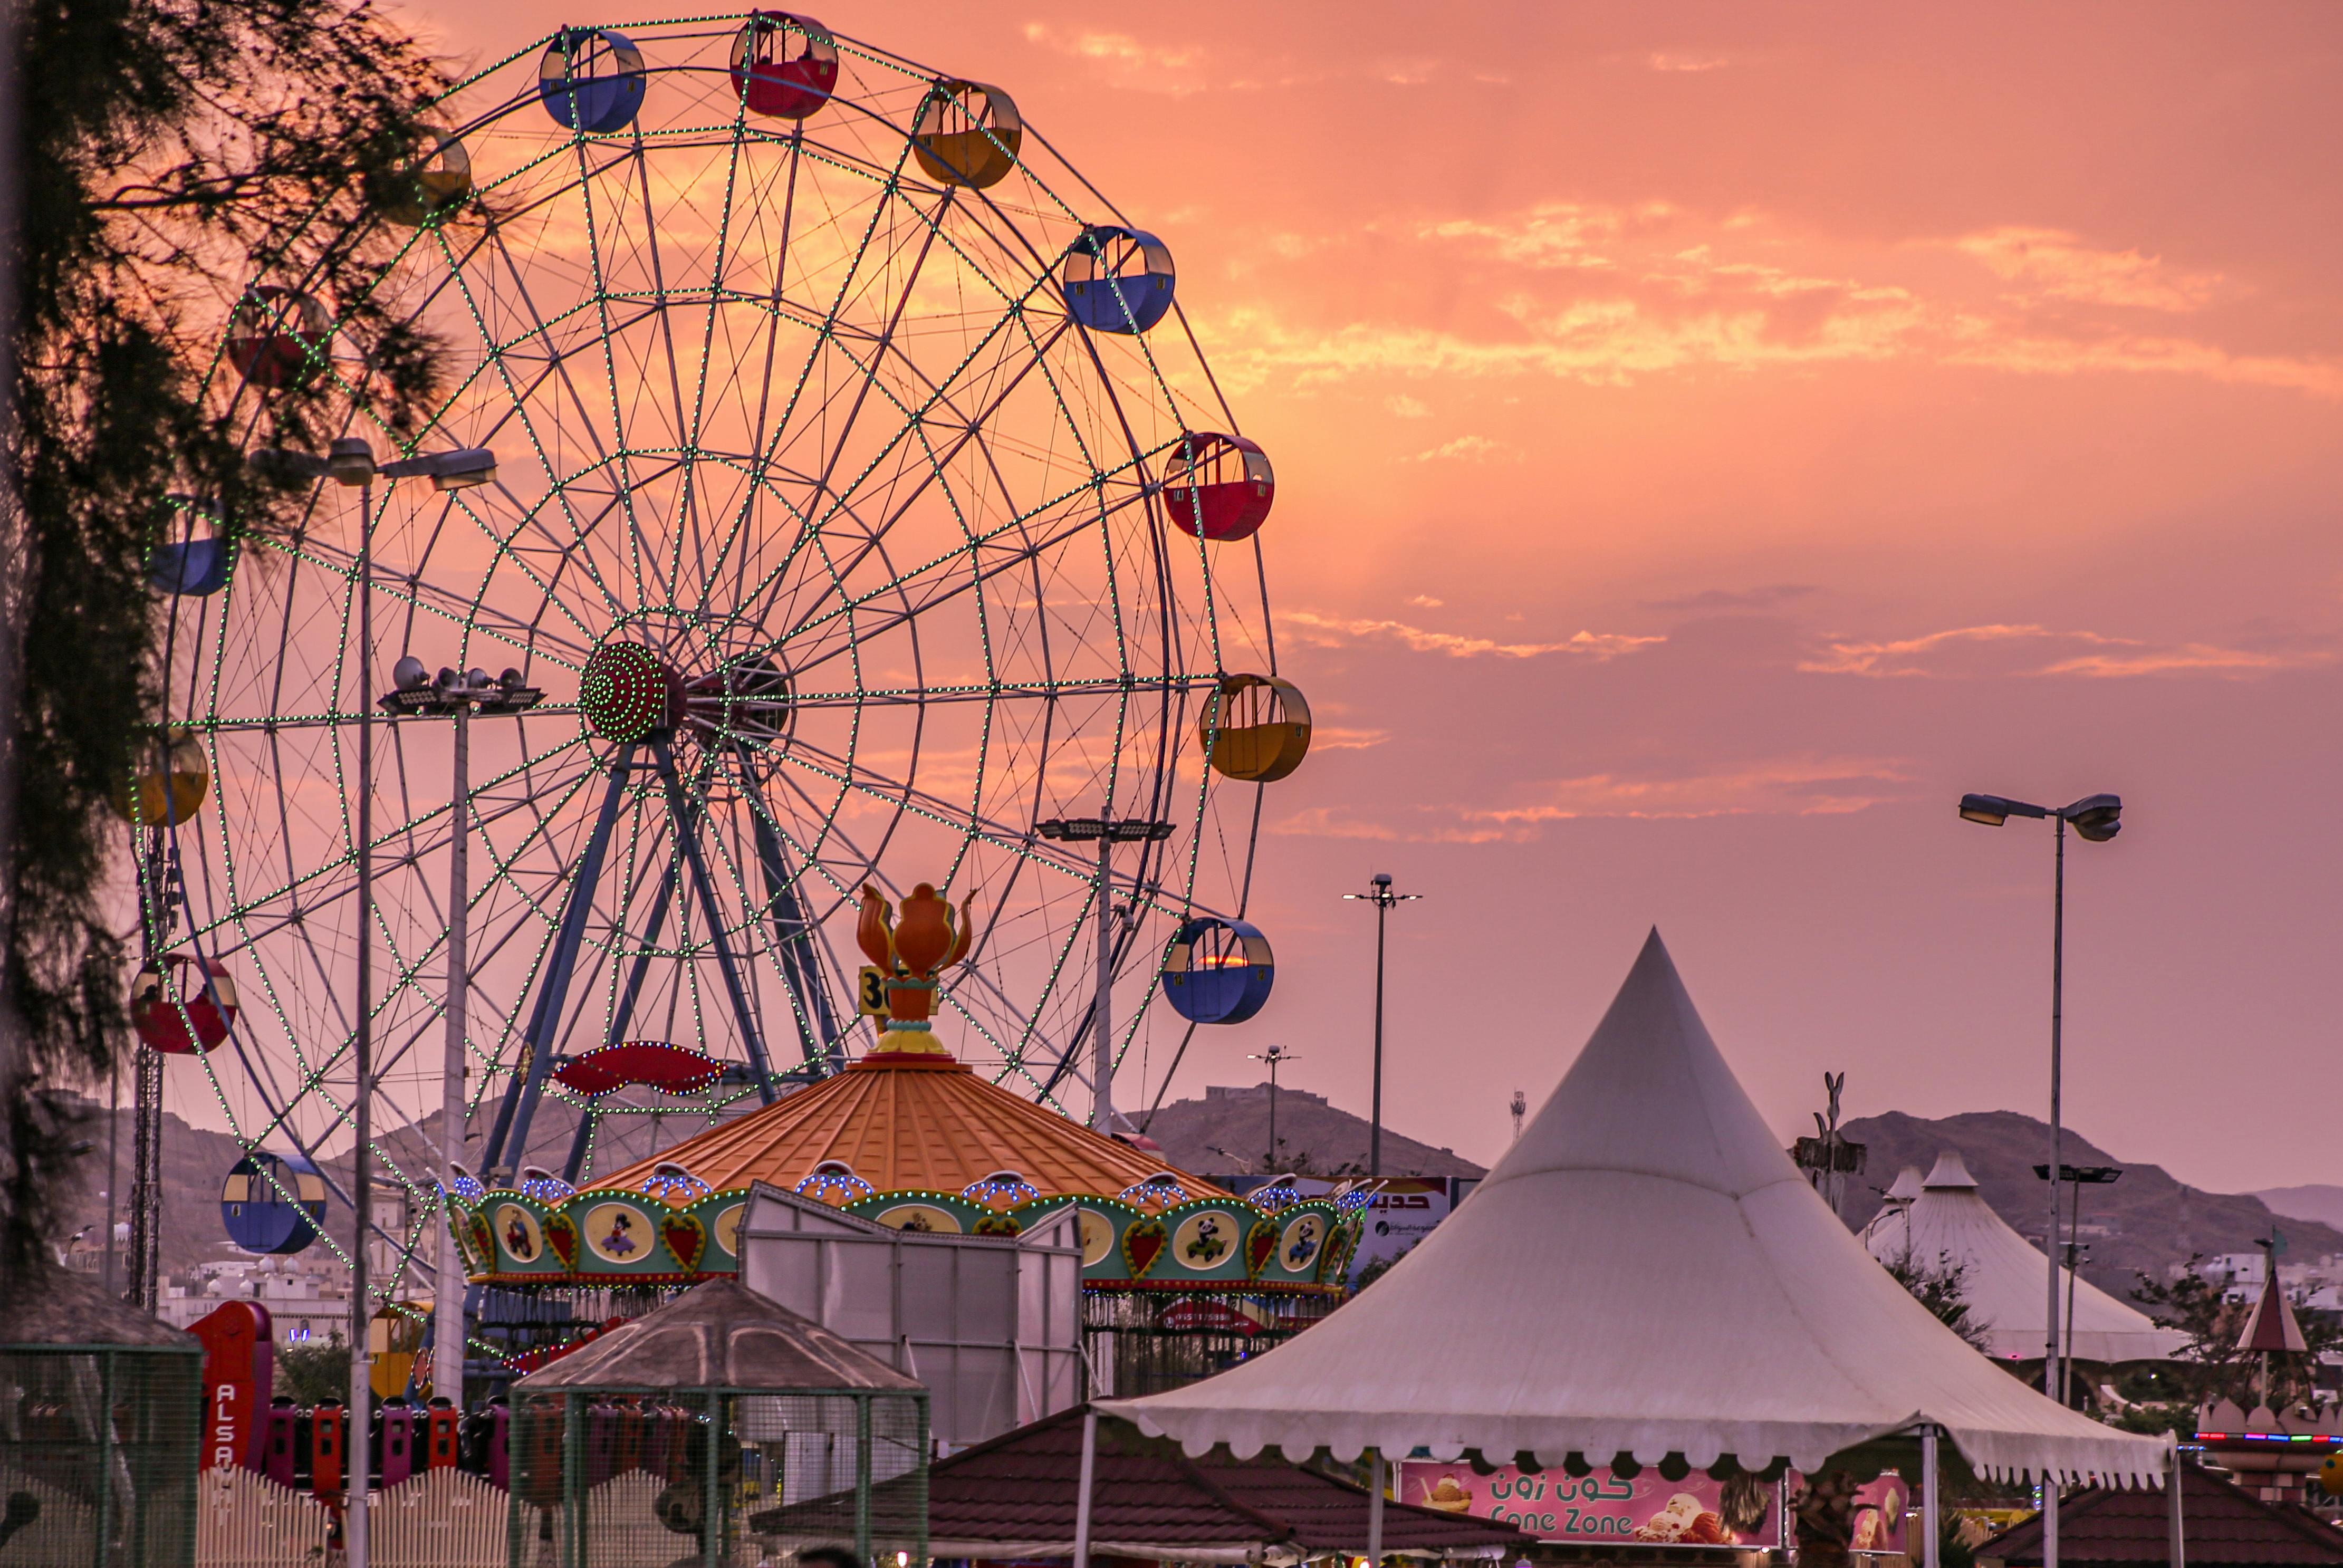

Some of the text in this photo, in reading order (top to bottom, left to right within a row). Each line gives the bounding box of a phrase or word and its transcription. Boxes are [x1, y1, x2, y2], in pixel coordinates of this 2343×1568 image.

[1491, 1473, 1634, 1502] كون زون
[1490, 1505, 1633, 1535] Cone Zone
